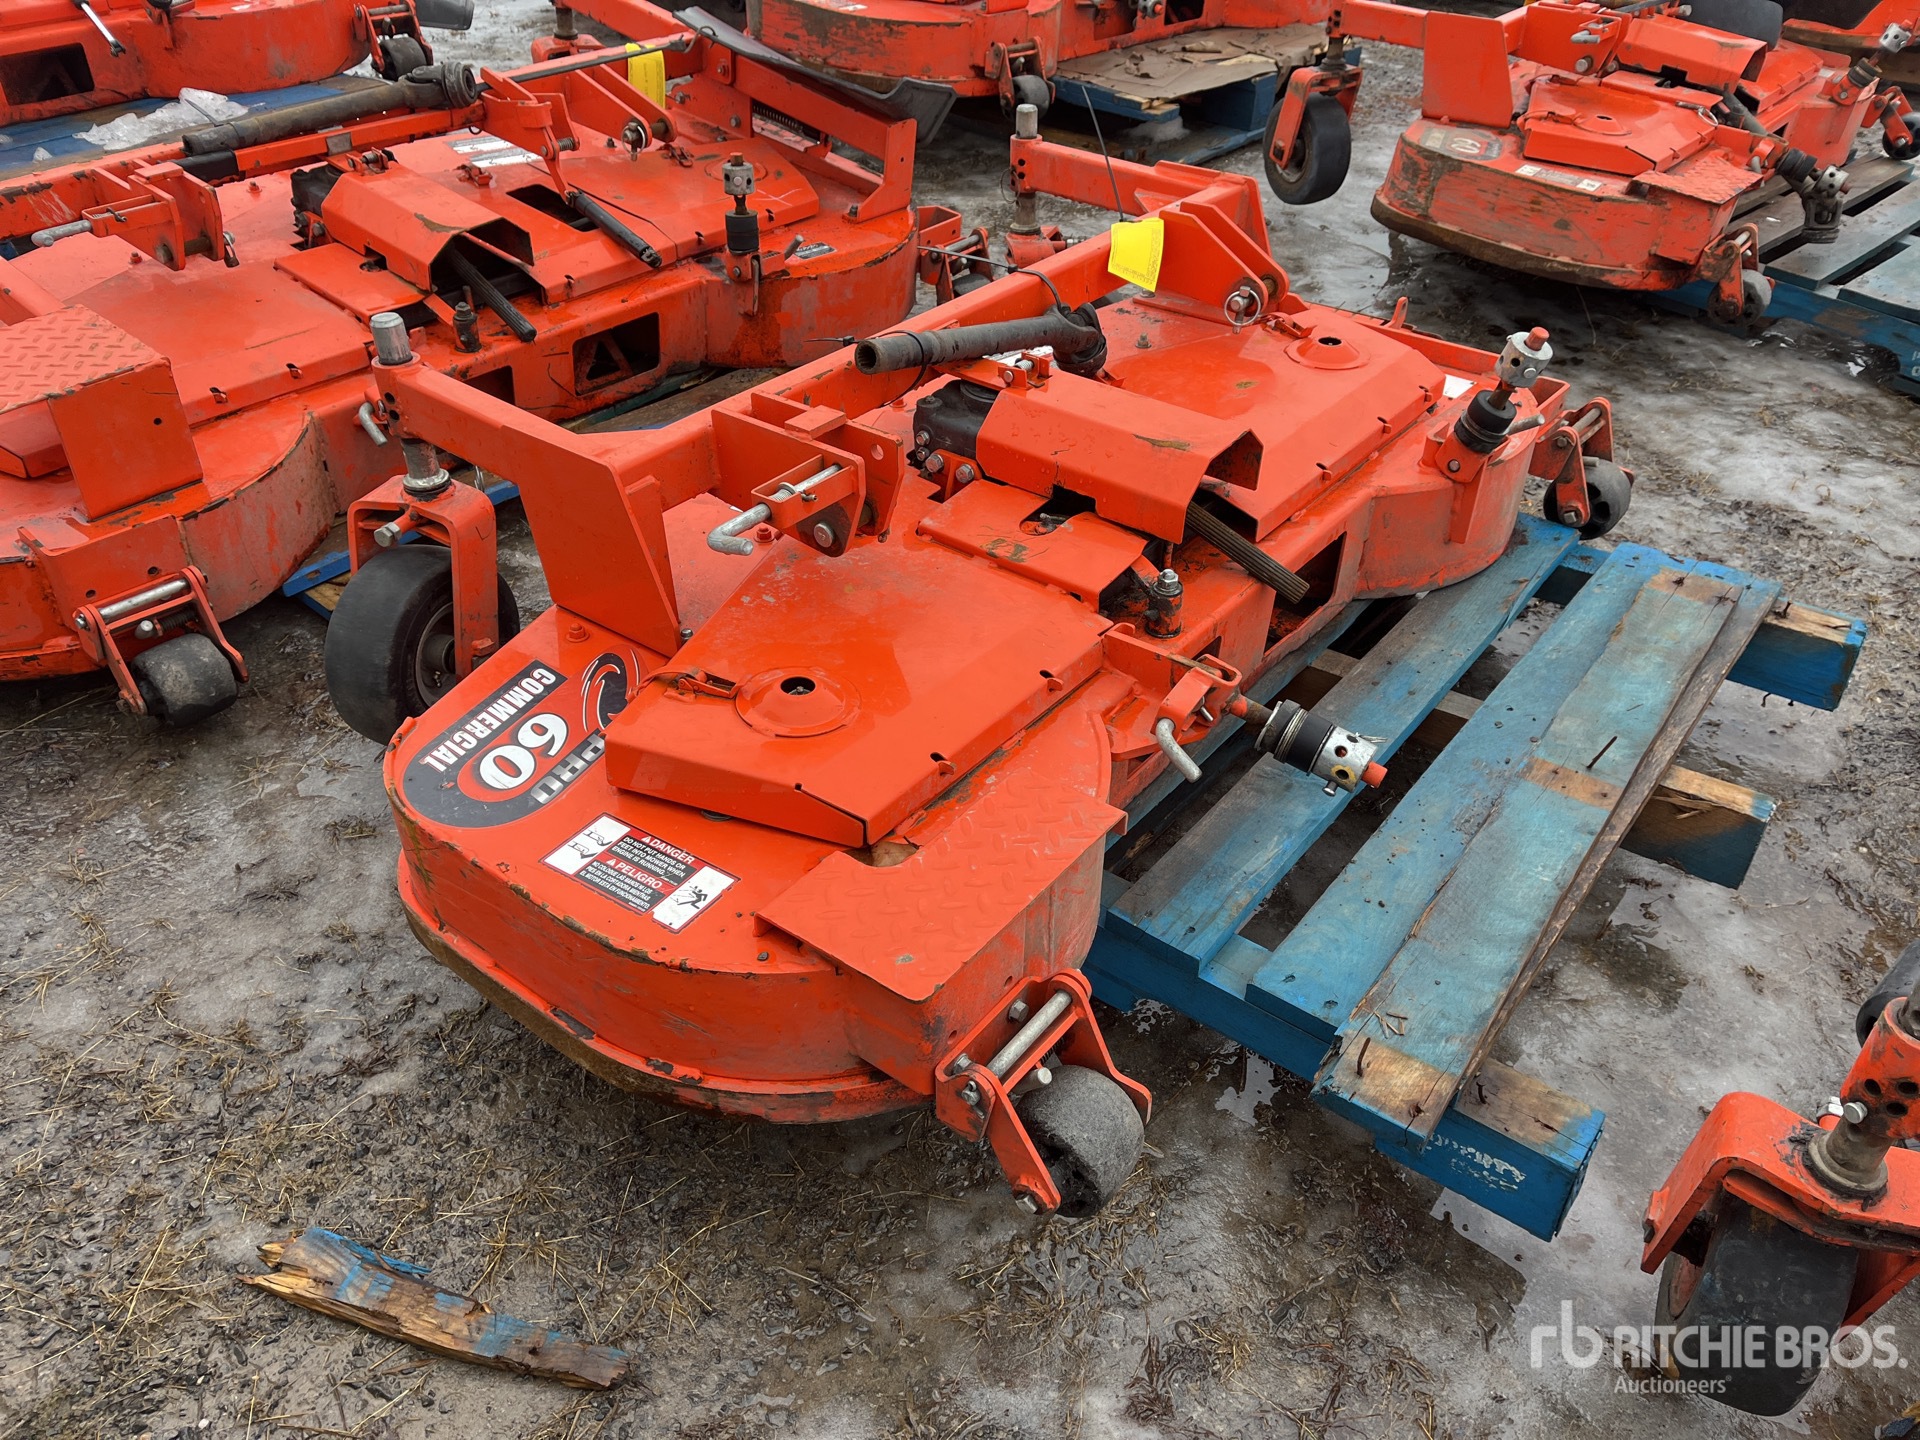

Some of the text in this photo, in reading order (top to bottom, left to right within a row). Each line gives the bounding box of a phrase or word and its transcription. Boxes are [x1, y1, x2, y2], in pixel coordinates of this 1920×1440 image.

[419, 668, 556, 773] COMMERCIAL
[480, 713, 568, 790] 60
[531, 734, 605, 804] PRO
[611, 846, 634, 859] ENGINE
[638, 859, 667, 875] RUNNING.
[617, 841, 686, 877] FEET INTO MOWER WHEN
[632, 841, 646, 850] NOT
[644, 847, 657, 855] PUT
[655, 853, 677, 865] HANDS
[650, 839, 695, 864] DANGER
[615, 862, 663, 889] PELIGRO
